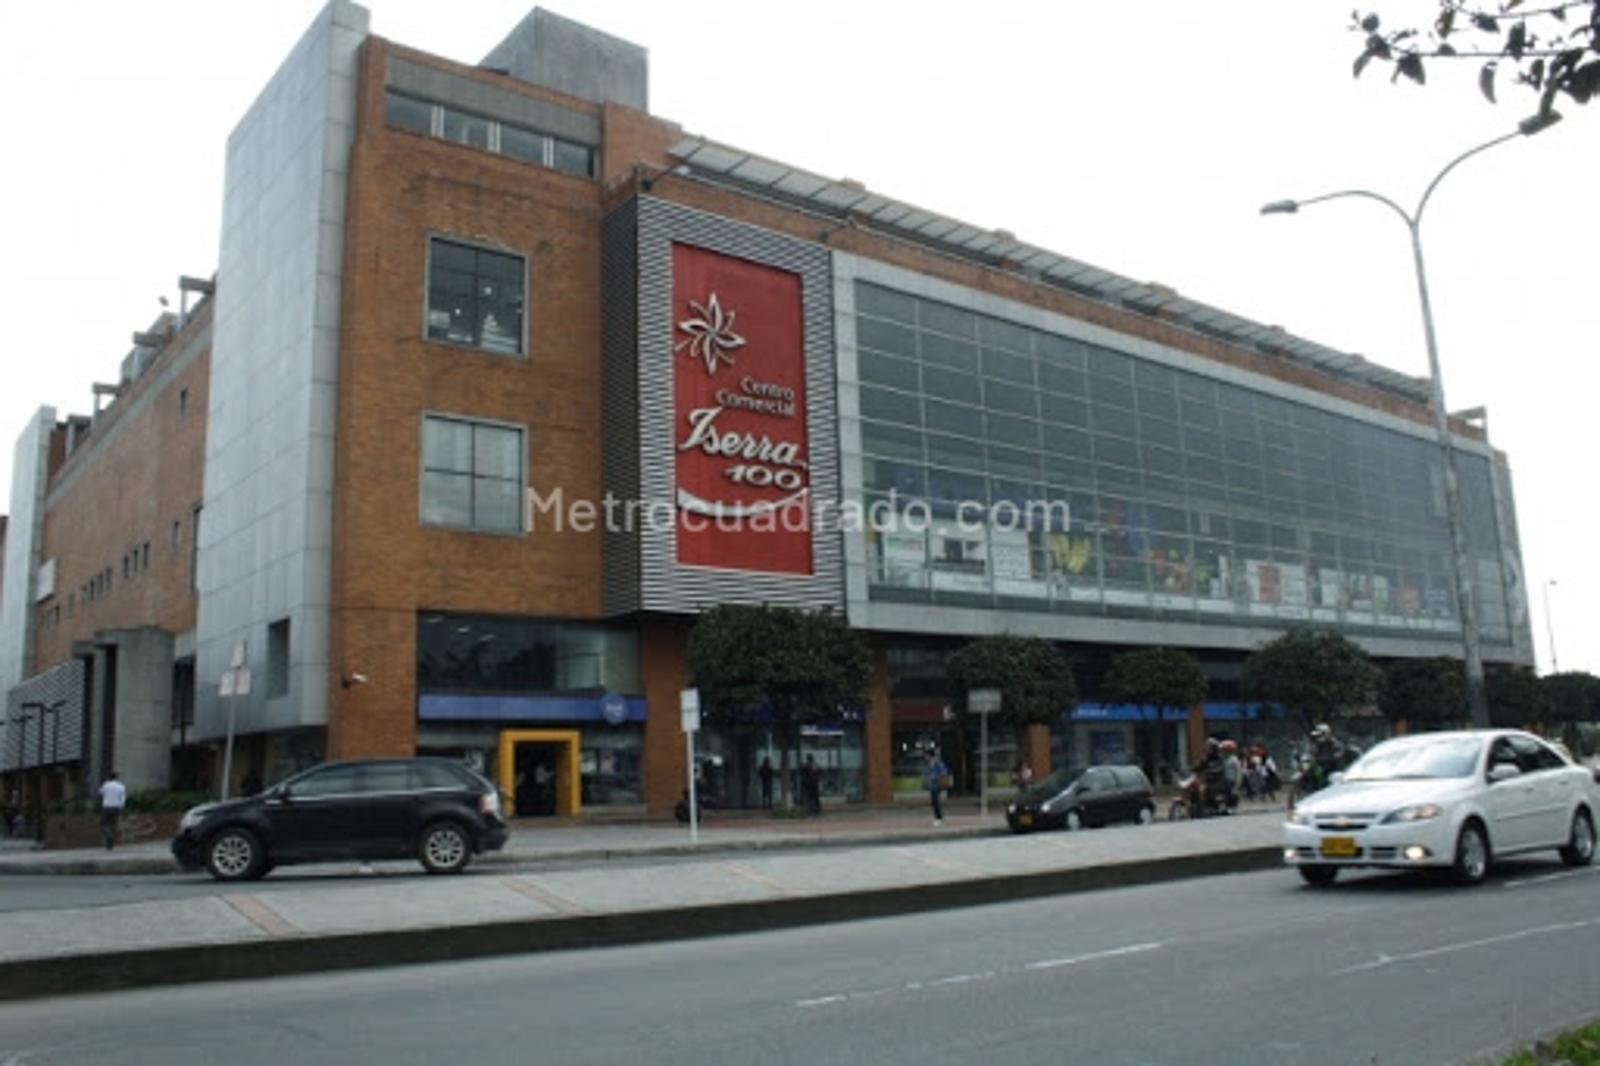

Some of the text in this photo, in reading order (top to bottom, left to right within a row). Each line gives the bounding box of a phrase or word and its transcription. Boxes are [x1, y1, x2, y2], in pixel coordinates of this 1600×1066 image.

[740, 375, 795, 400] Centro
[714, 387, 796, 417] Comercial
[677, 405, 807, 468] Iserra
[724, 464, 801, 490] 100
